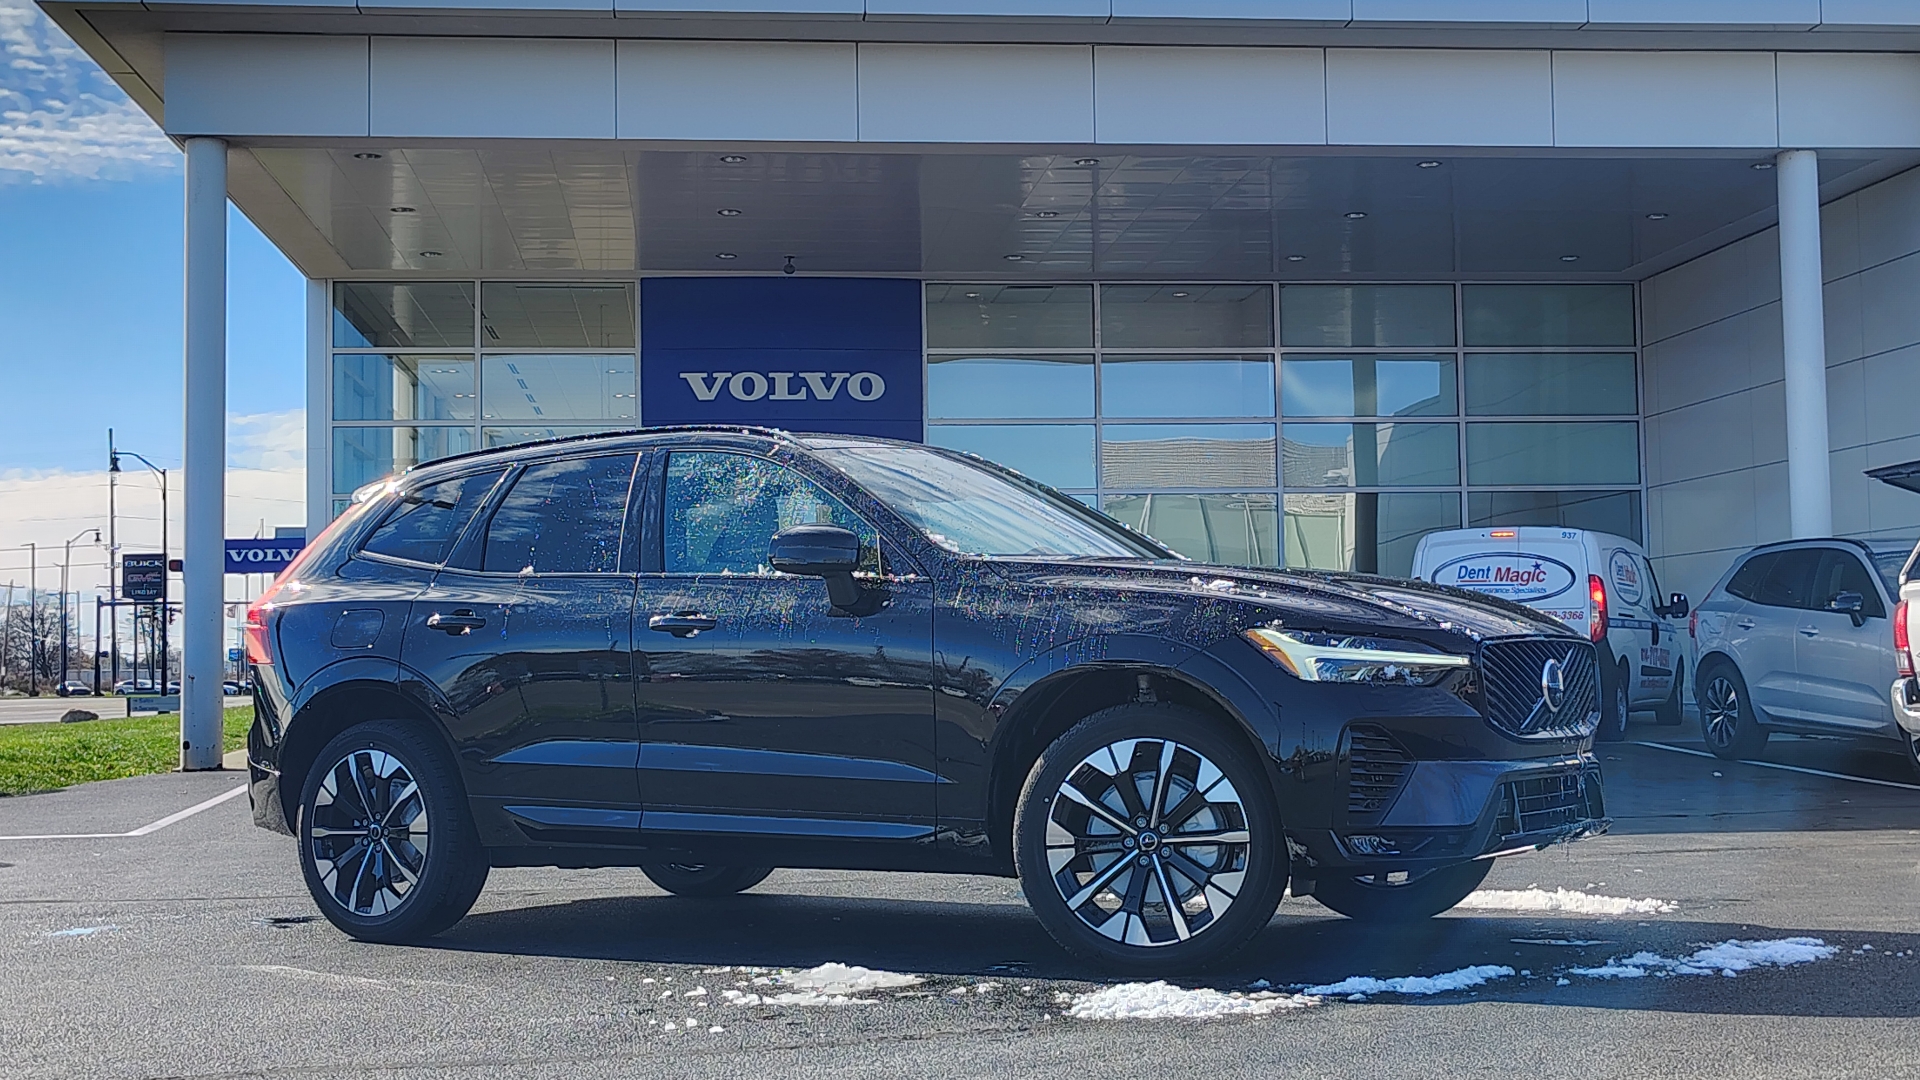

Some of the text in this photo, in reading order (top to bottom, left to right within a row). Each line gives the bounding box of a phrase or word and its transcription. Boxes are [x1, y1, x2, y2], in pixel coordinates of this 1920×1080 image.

[679, 372, 886, 401] VOLVO
[1561, 531, 1577, 539] 937
[226, 549, 301, 562] VOLV
[1457, 562, 1547, 586] Dent Magic
[1511, 587, 1547, 595] Specialists
